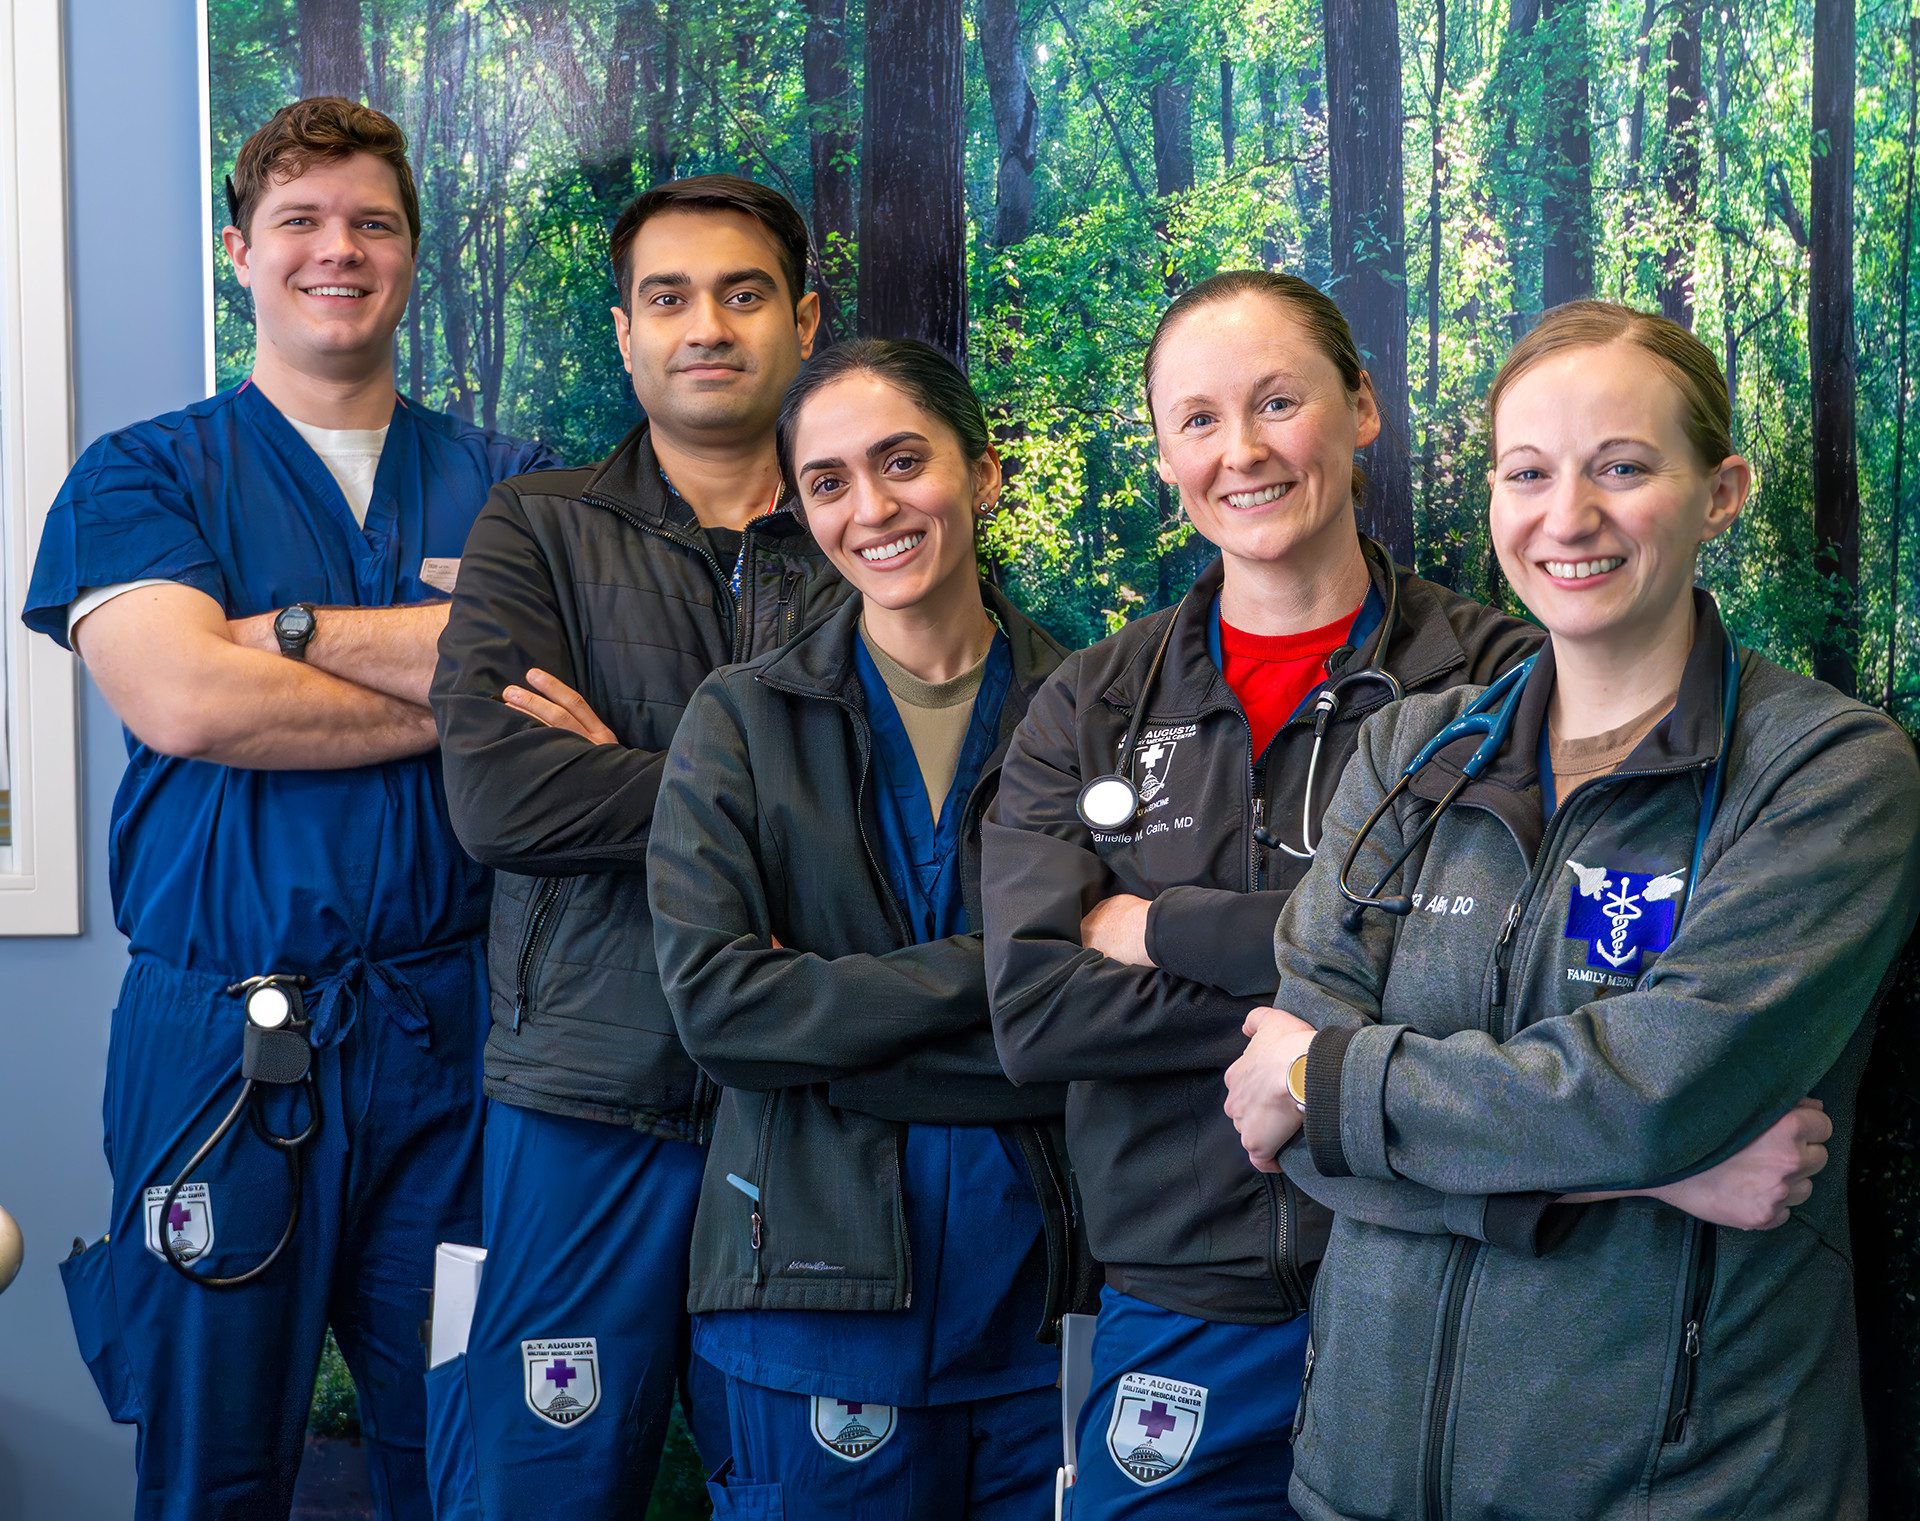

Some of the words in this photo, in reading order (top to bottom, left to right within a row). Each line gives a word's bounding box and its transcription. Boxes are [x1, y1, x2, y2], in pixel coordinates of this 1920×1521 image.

[1145, 724, 1197, 739] AUGUSTA
[1146, 820, 1170, 836] Cain,
[1174, 816, 1193, 829] MD
[1450, 896, 1474, 915] DO
[1567, 968, 1606, 984] FAMILY
[547, 1341, 593, 1350] AUGUSTA
[1123, 1384, 1150, 1396] MILITARY
[1150, 1390, 1177, 1402] MEDICAL
[1177, 1396, 1201, 1407] CENTER
[1149, 1379, 1202, 1398] AUGUSTA
